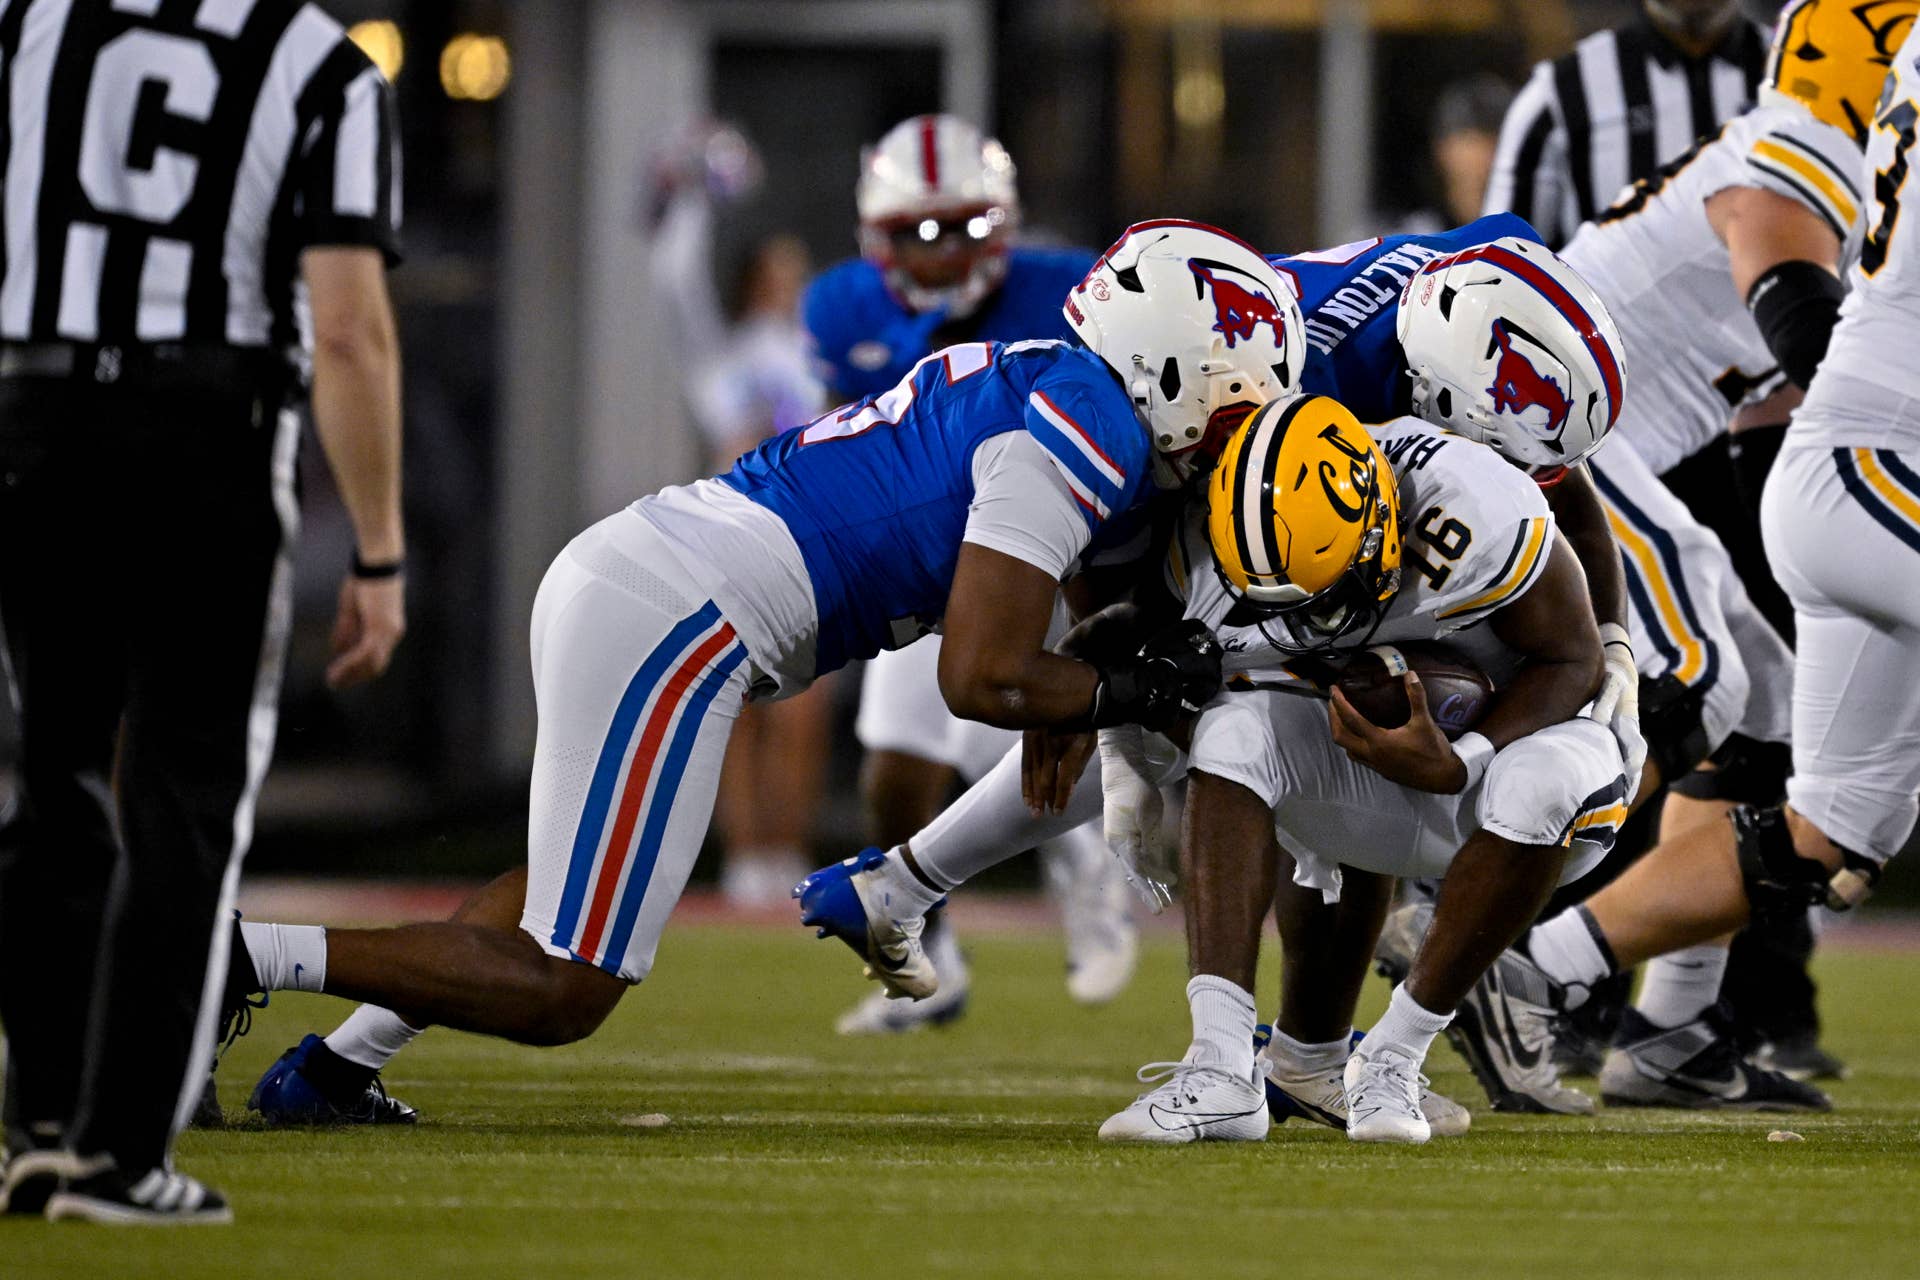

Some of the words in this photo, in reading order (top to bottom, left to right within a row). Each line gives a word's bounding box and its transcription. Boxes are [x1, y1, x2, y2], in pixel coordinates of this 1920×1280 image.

[78, 26, 221, 224] C
[1318, 243, 1444, 329] WALTON
[1318, 423, 1378, 531] Cal
[1401, 506, 1472, 591] 16
